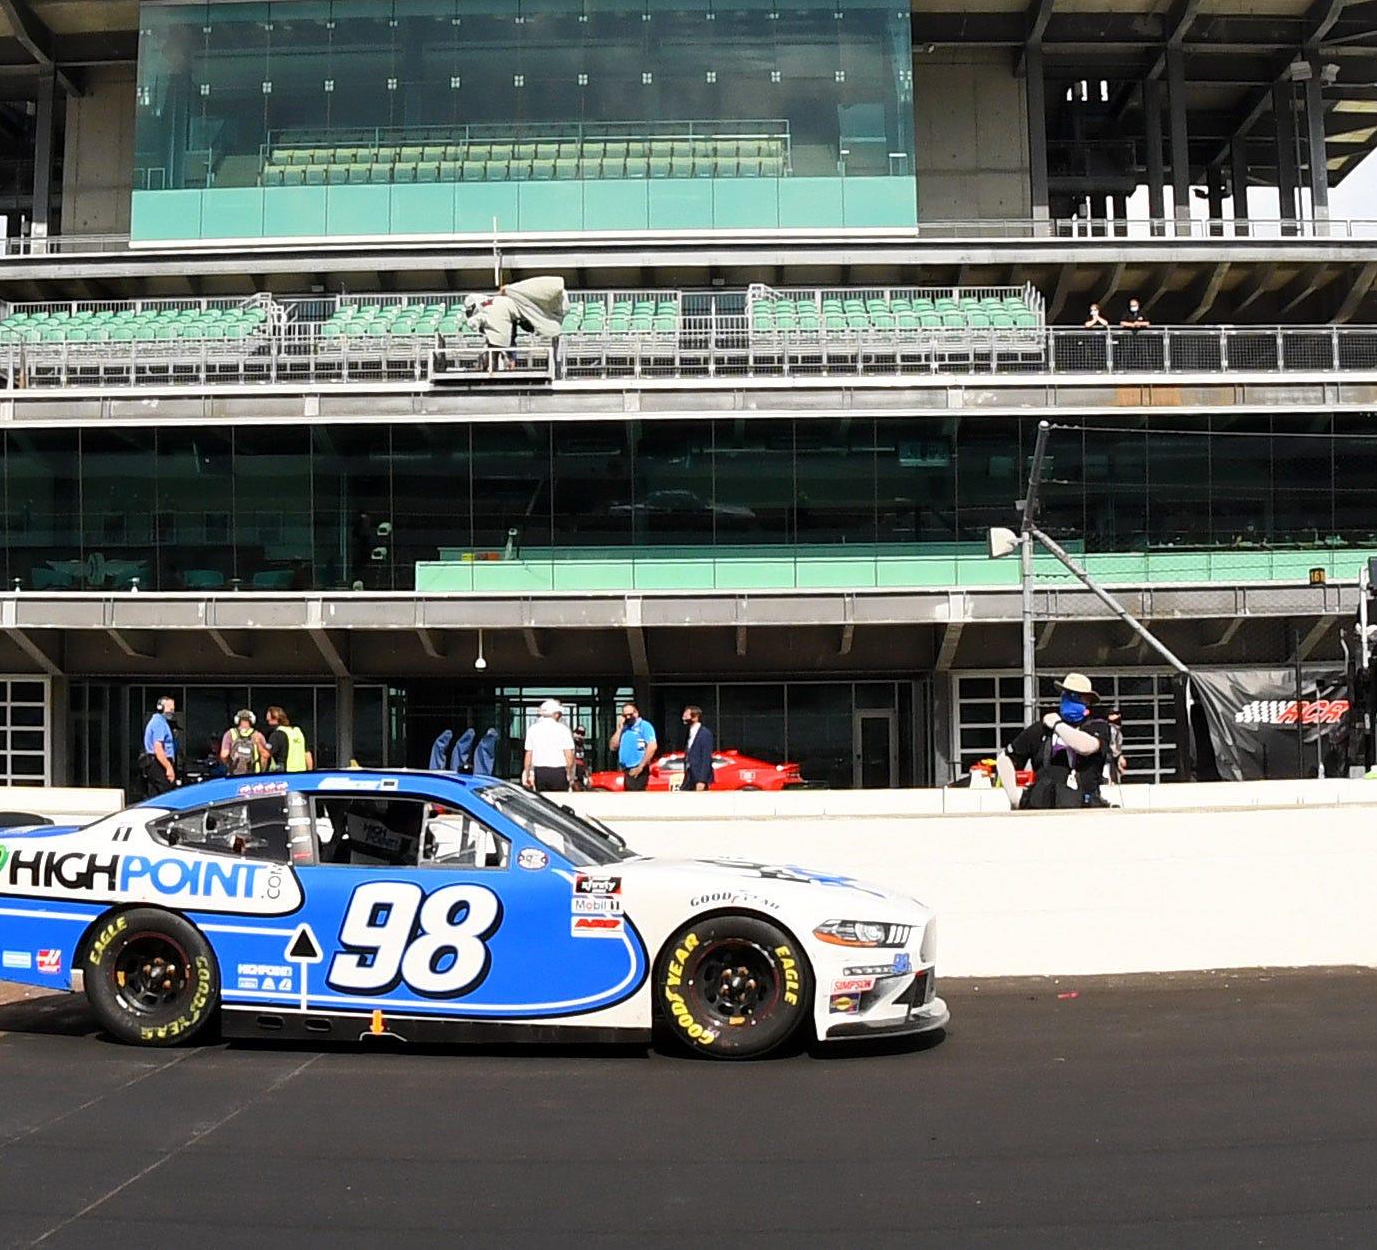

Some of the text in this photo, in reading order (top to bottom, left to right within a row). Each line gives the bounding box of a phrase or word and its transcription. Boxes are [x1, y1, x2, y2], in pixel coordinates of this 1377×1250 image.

[575, 899, 607, 910] Mobil
[89, 916, 128, 966] EAGLE
[326, 880, 505, 999] 98
[665, 933, 715, 1045] GOODYEAR
[775, 945, 800, 1007] EAGLE
[834, 980, 872, 990] SIMPSON
